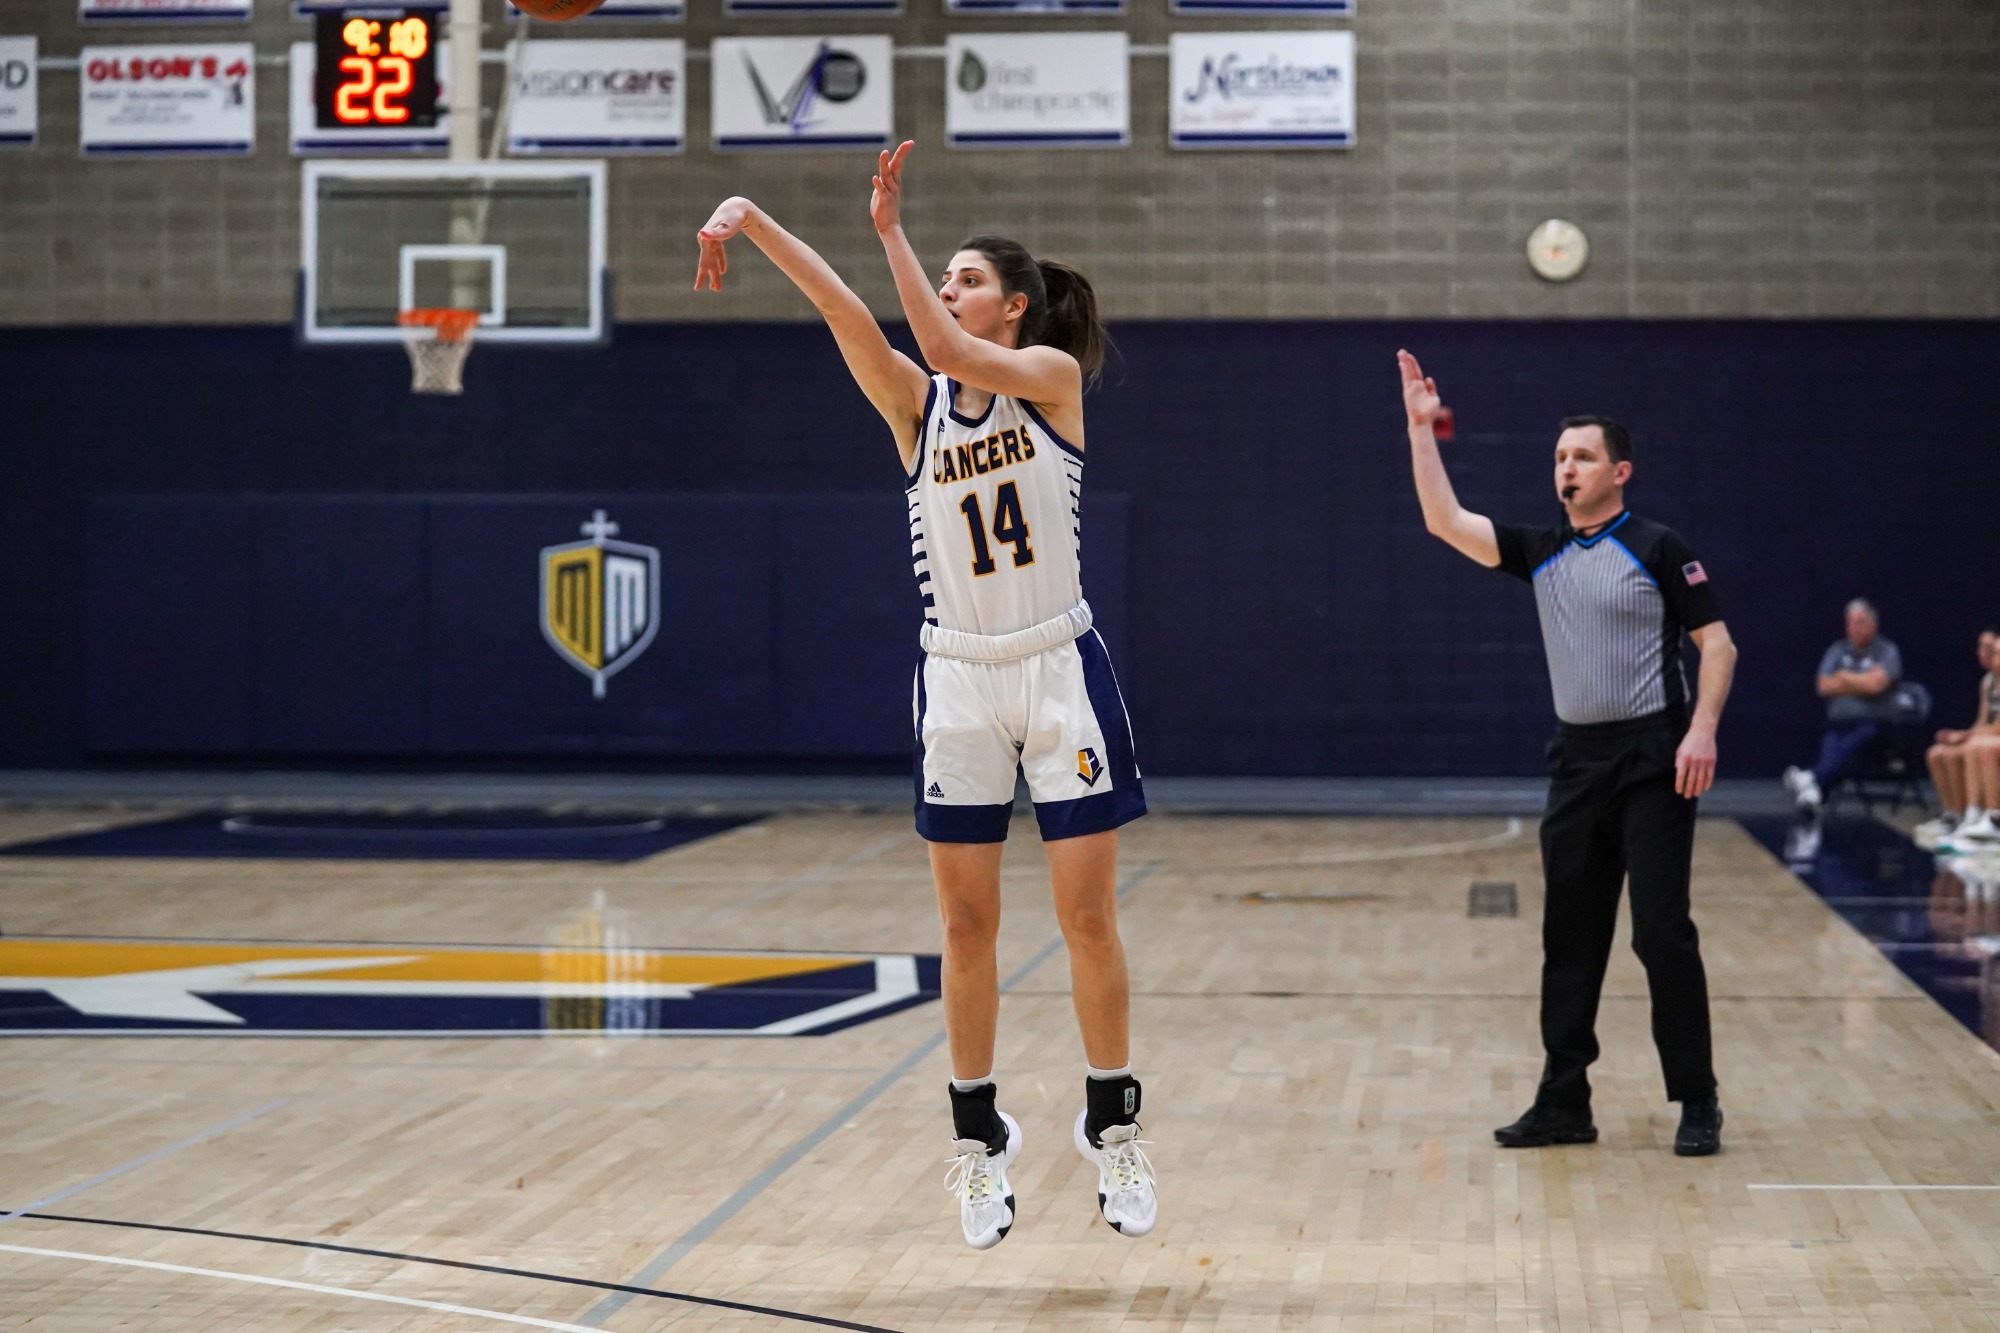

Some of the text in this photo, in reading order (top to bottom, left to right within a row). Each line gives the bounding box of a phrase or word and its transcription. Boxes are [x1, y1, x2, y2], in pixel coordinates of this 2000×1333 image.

[343, 18, 427, 58] 9:10
[87, 56, 218, 83] OLSON'S
[335, 56, 412, 123] 22
[933, 424, 1036, 484] LANCERS
[959, 479, 1035, 577] 14
